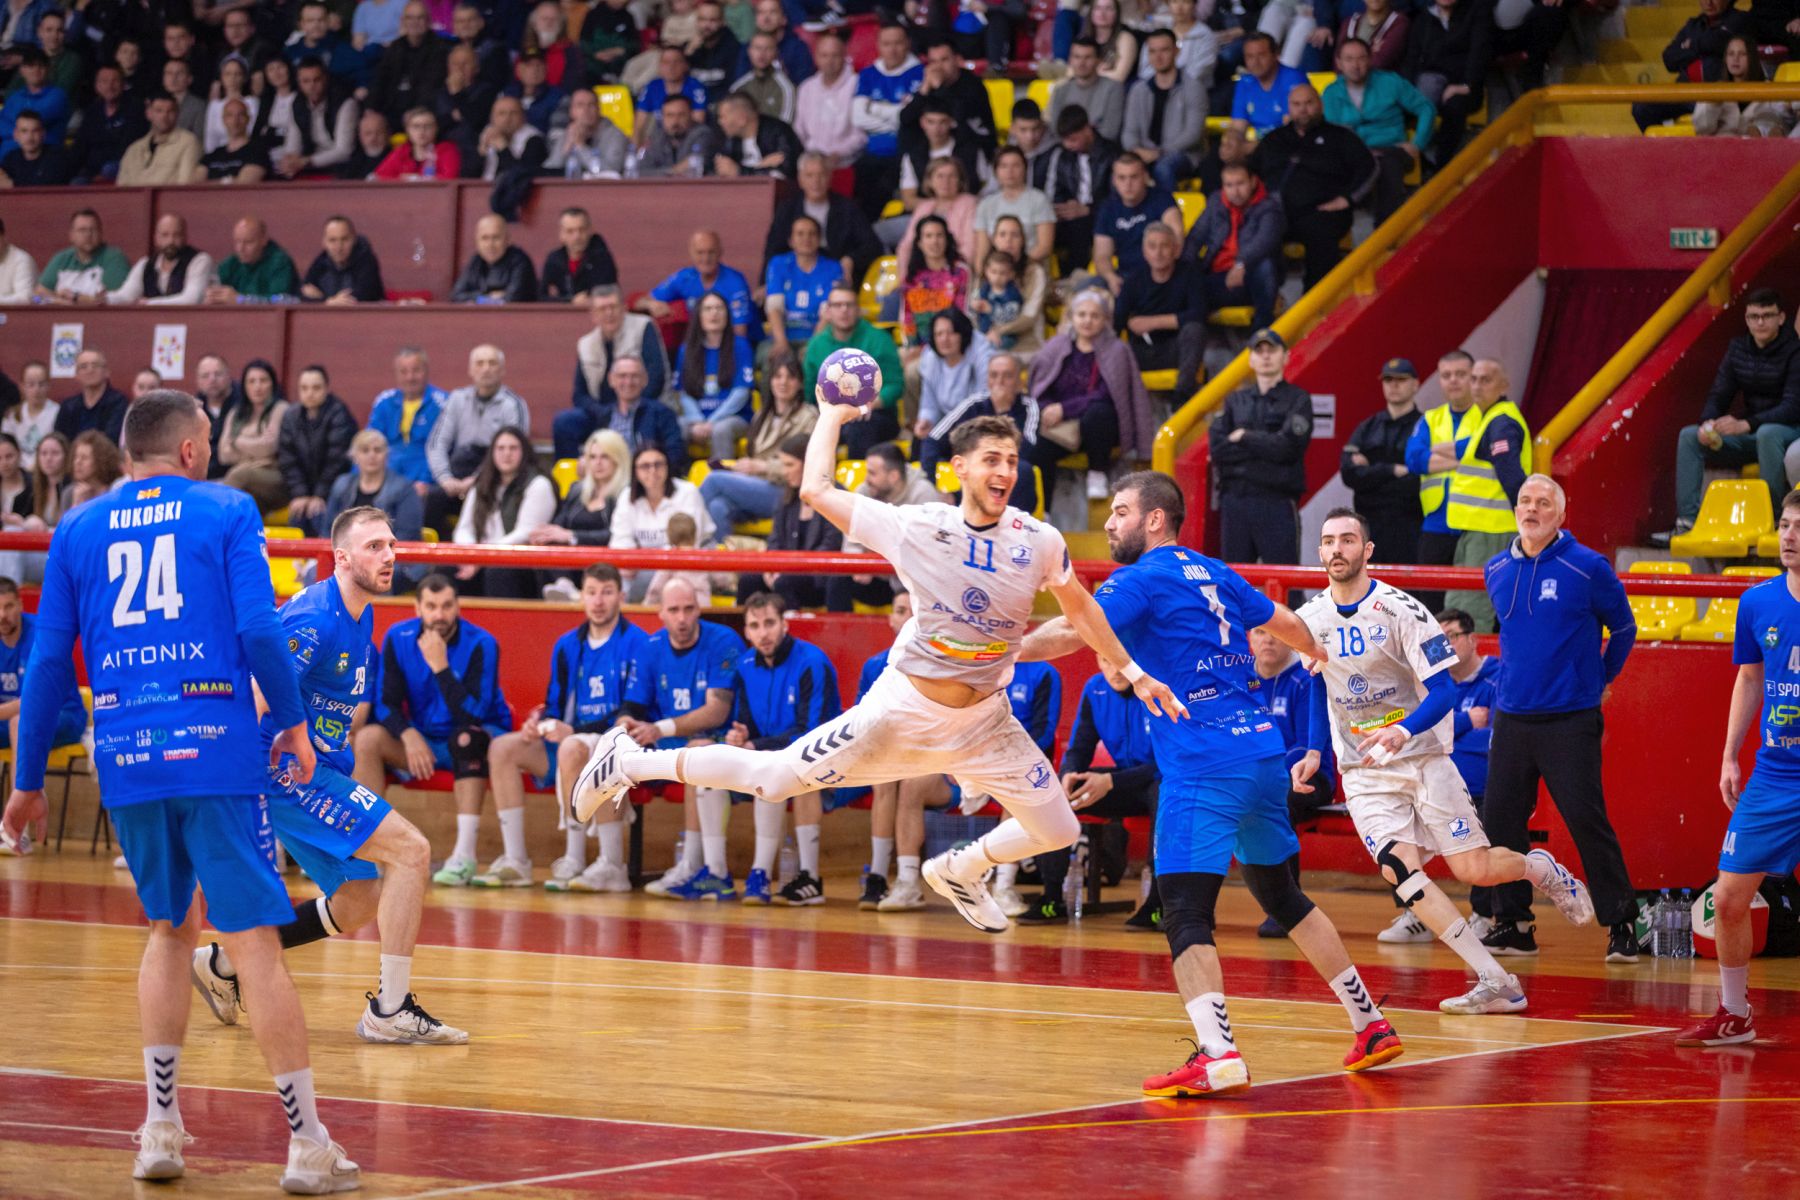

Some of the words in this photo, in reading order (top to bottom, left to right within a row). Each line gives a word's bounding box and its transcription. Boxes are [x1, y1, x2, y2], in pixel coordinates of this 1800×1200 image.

[1670, 231, 1697, 248] EXIT
[109, 501, 182, 530] KUKOSKI
[963, 533, 997, 573] 11
[107, 533, 184, 628] 24
[1199, 584, 1231, 646] 7
[1337, 626, 1365, 658] 18
[102, 642, 206, 671] AITONIX
[182, 682, 233, 694] TAMARO
[1188, 687, 1217, 701] Andros
[1387, 710, 1403, 722] 400
[349, 784, 378, 811] 29
[1722, 829, 1737, 856] 44
